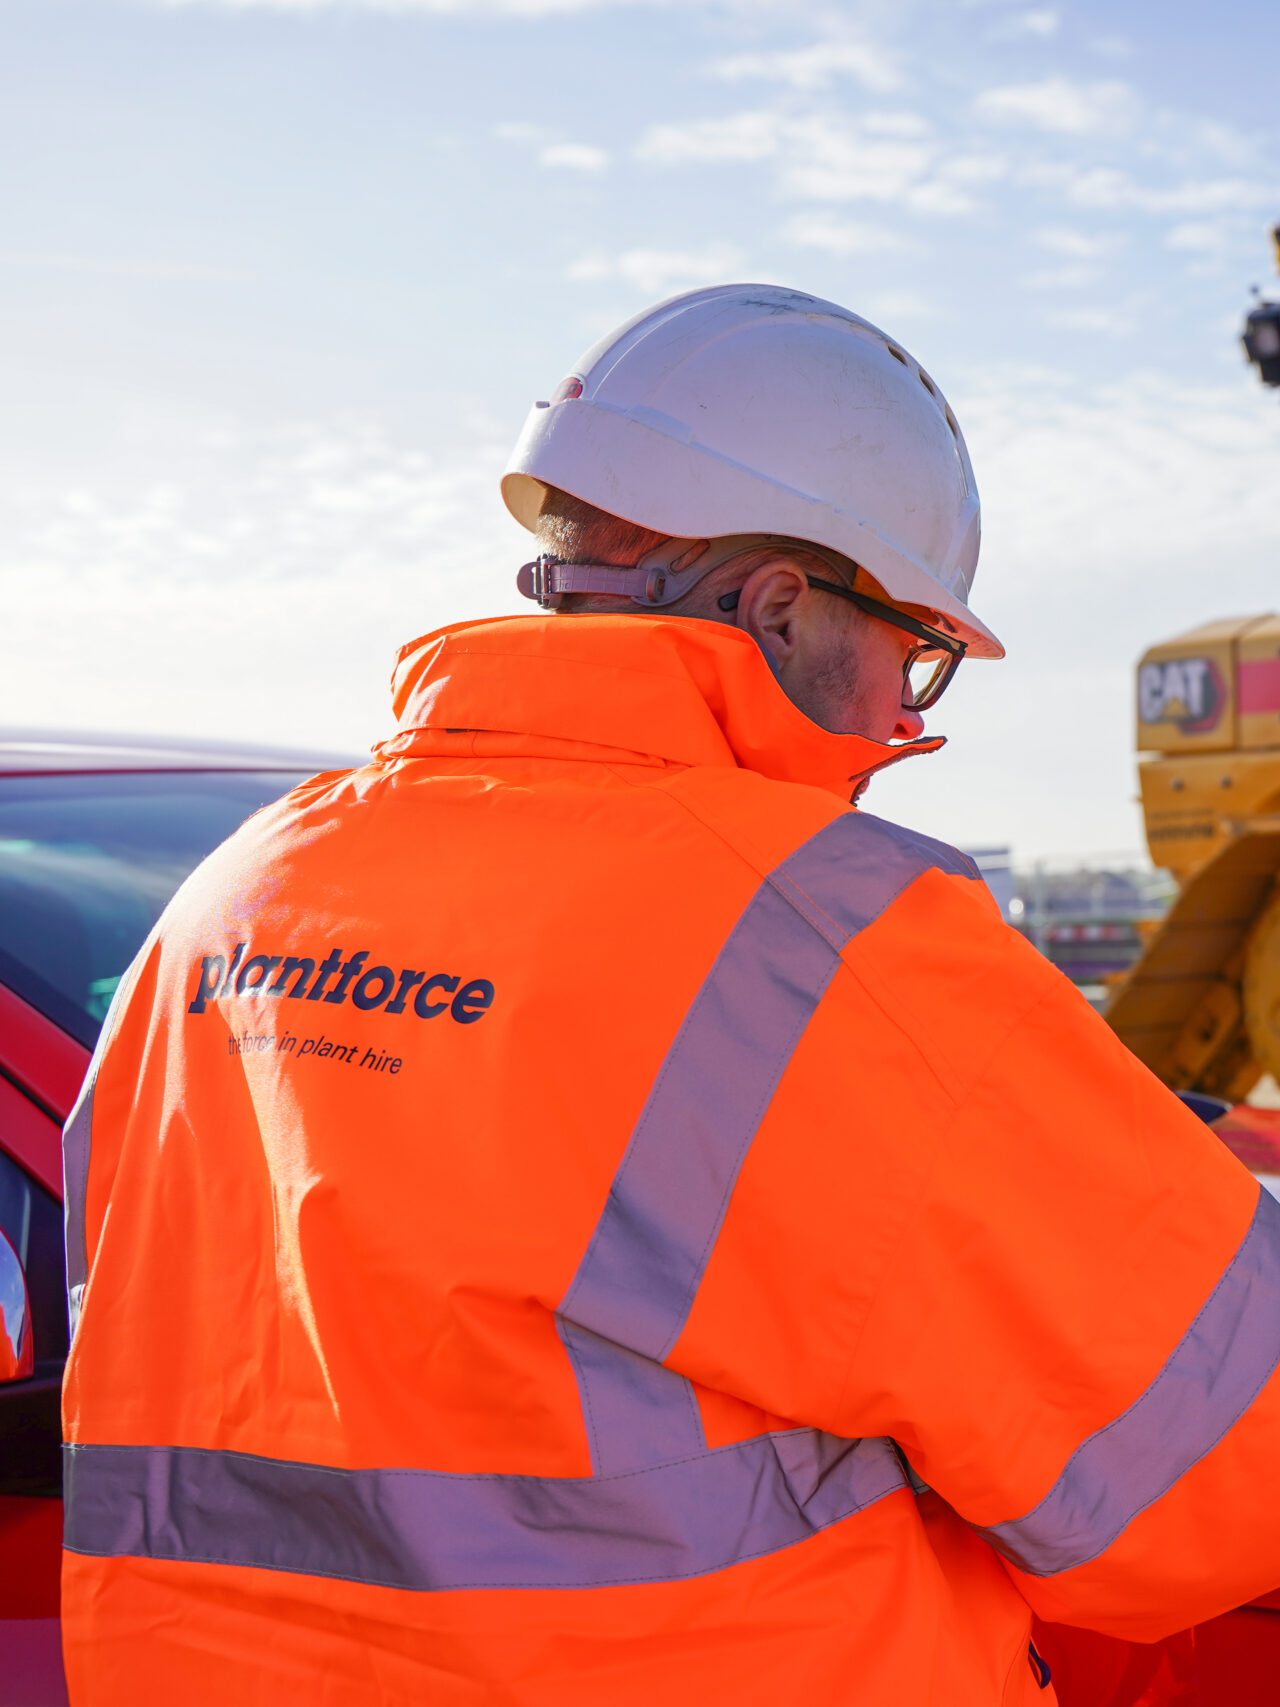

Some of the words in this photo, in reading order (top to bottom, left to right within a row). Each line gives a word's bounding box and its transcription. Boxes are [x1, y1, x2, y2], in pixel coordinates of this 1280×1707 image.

[1139, 658, 1209, 723] CAT
[188, 942, 496, 1025] plantforce
[277, 1031, 297, 1051] in
[296, 1035, 359, 1063] plant
[359, 1047, 403, 1074] hire
